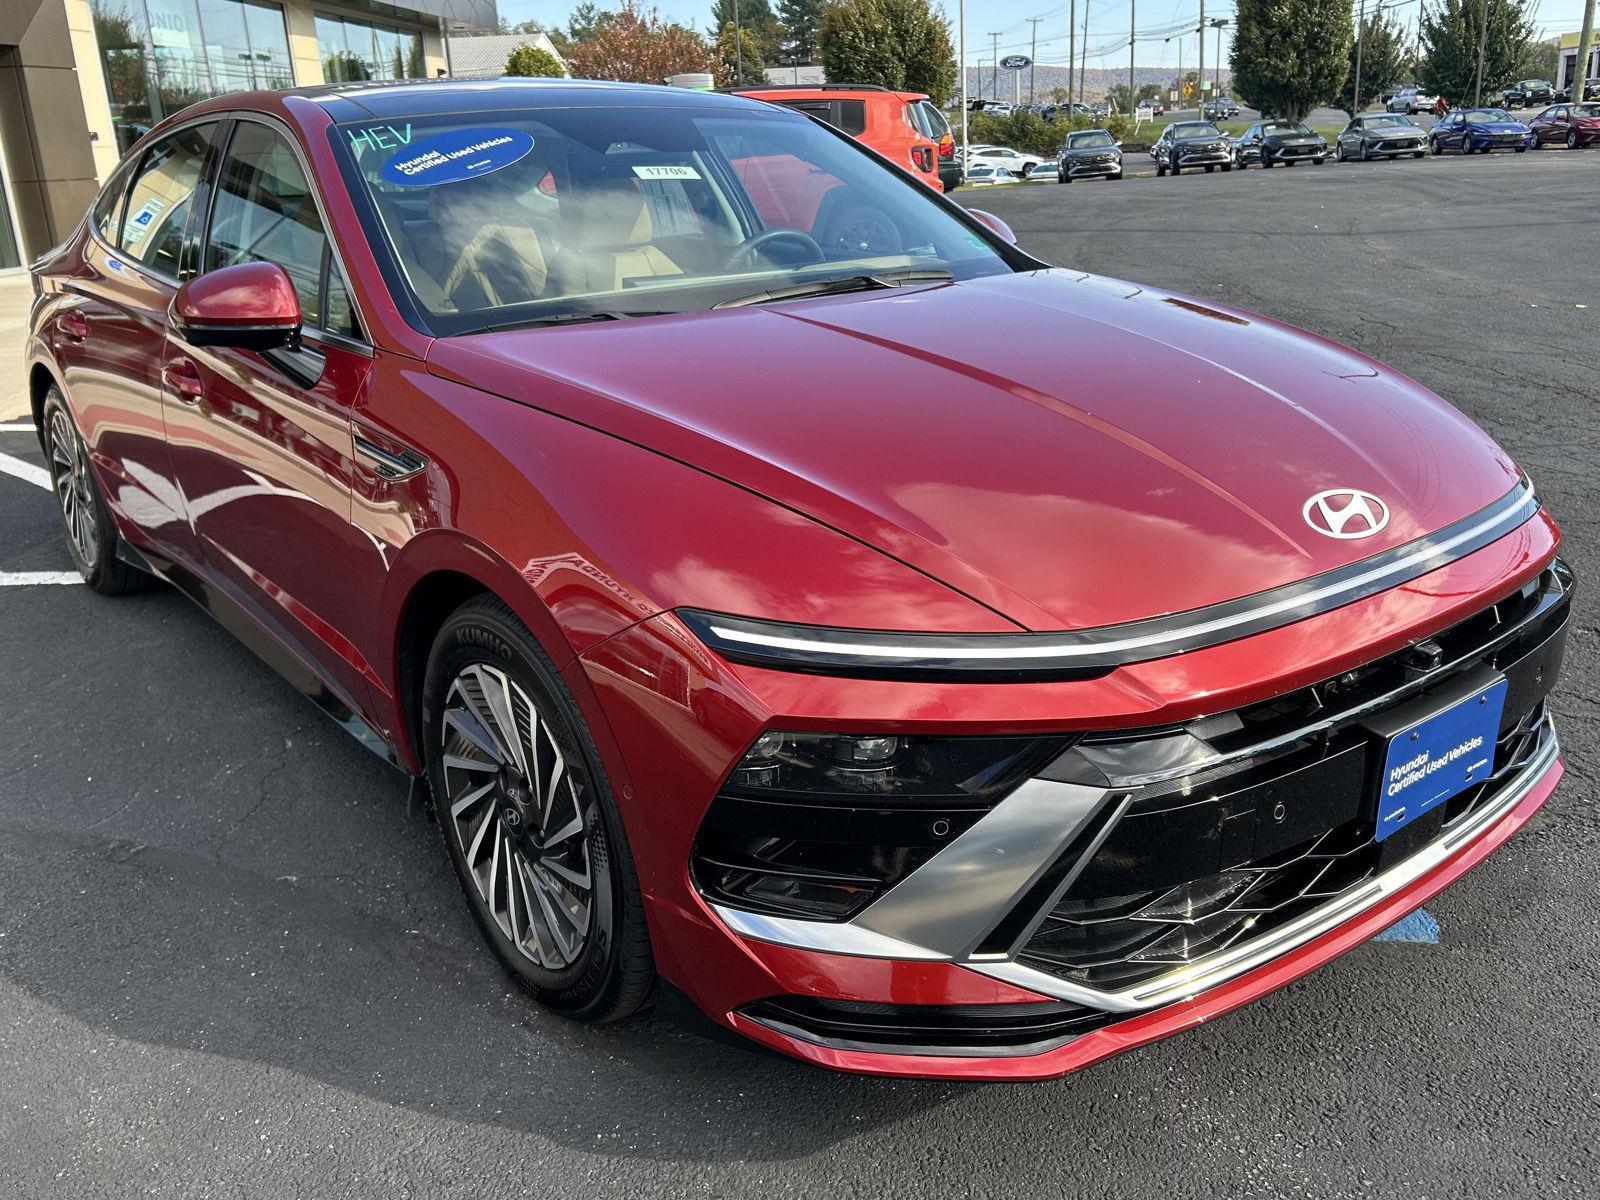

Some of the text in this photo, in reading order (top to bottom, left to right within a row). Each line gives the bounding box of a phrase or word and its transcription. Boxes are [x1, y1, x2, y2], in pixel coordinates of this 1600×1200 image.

[347, 123, 411, 151] HEV
[394, 150, 441, 171] Hyundai
[404, 155, 450, 175] Certified
[446, 146, 475, 160] Used
[470, 136, 513, 151] Vehicles
[646, 167, 687, 176] 17706
[456, 627, 512, 661] KUMHO
[1388, 765, 1426, 796] Certified
[1426, 752, 1449, 774] Used
[1449, 736, 1484, 762] Vehicles
[1390, 749, 1429, 781] Hyundai
